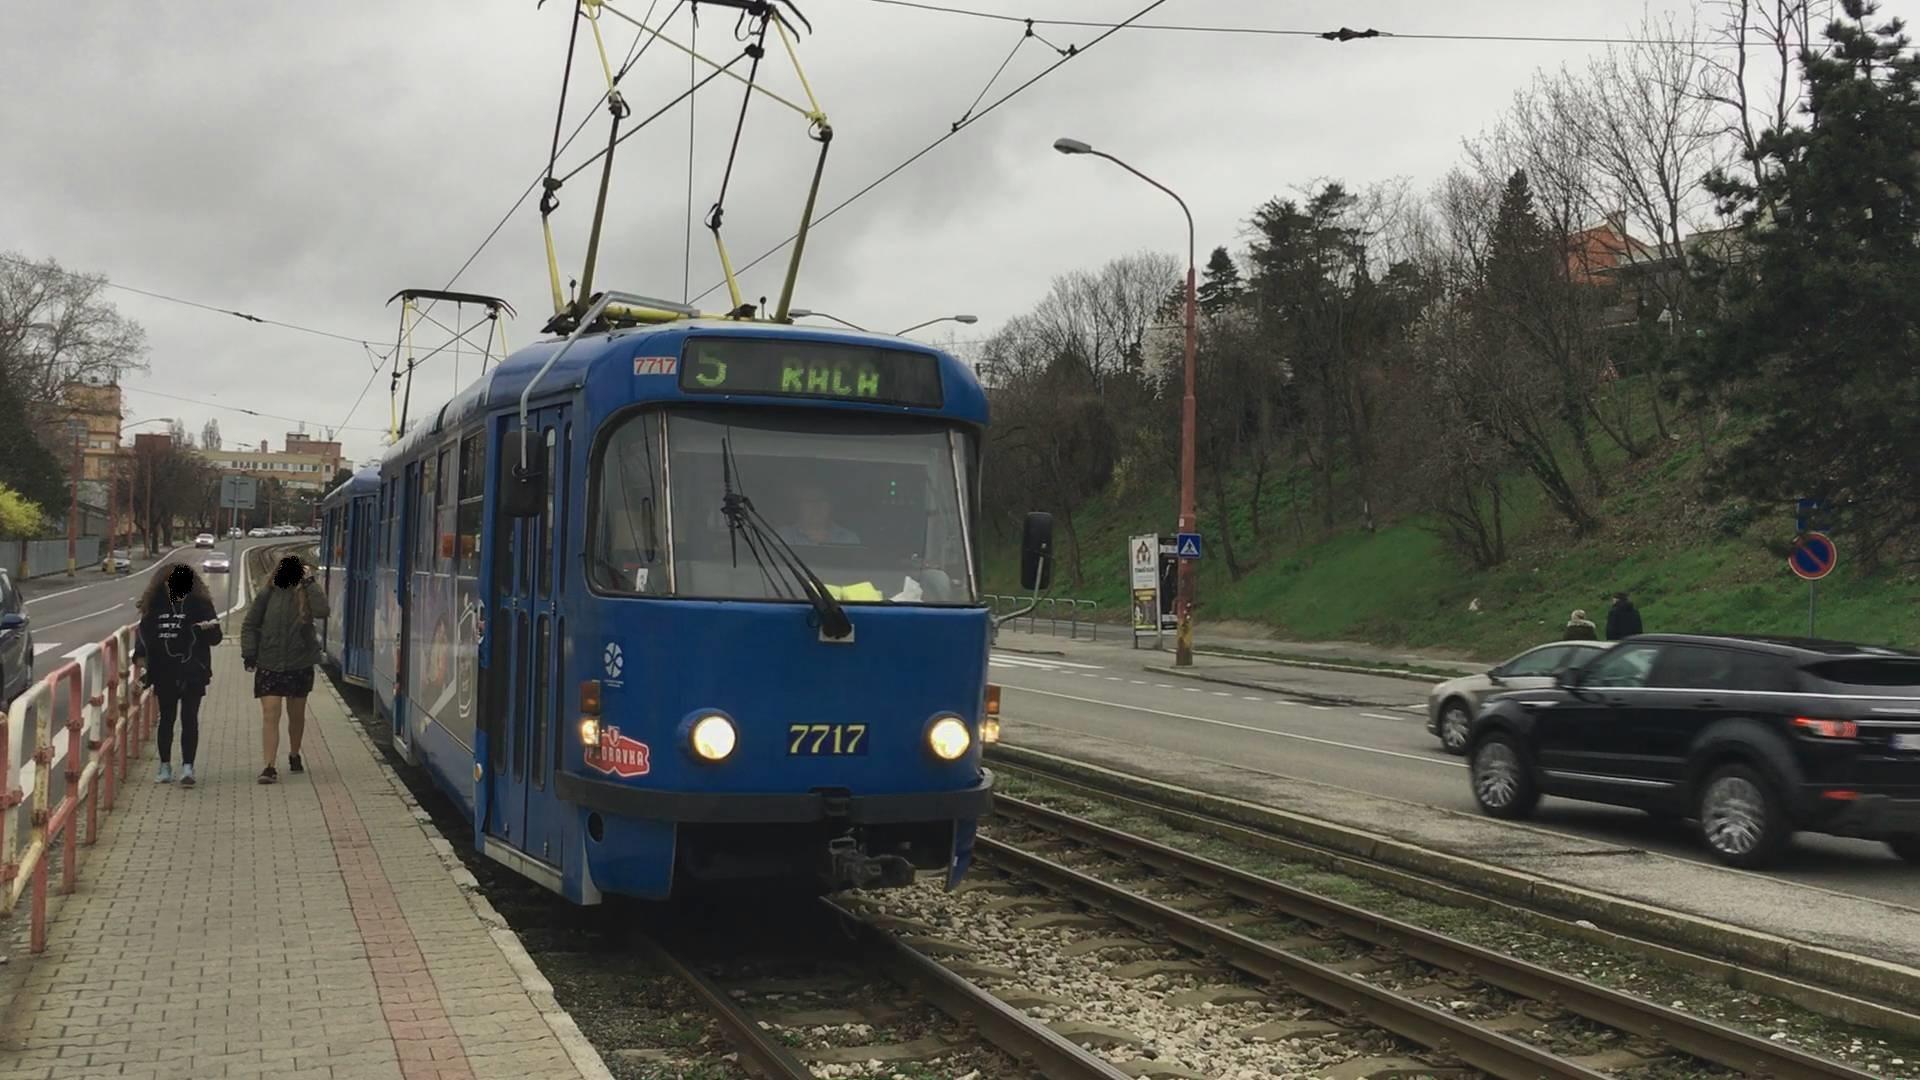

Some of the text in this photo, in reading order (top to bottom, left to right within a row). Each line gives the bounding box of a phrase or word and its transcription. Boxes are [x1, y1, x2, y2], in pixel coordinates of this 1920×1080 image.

[635, 358, 676, 374] 7717
[696, 346, 727, 387] 5
[789, 724, 866, 754] 7717
[588, 744, 644, 767] PDRAVKA
